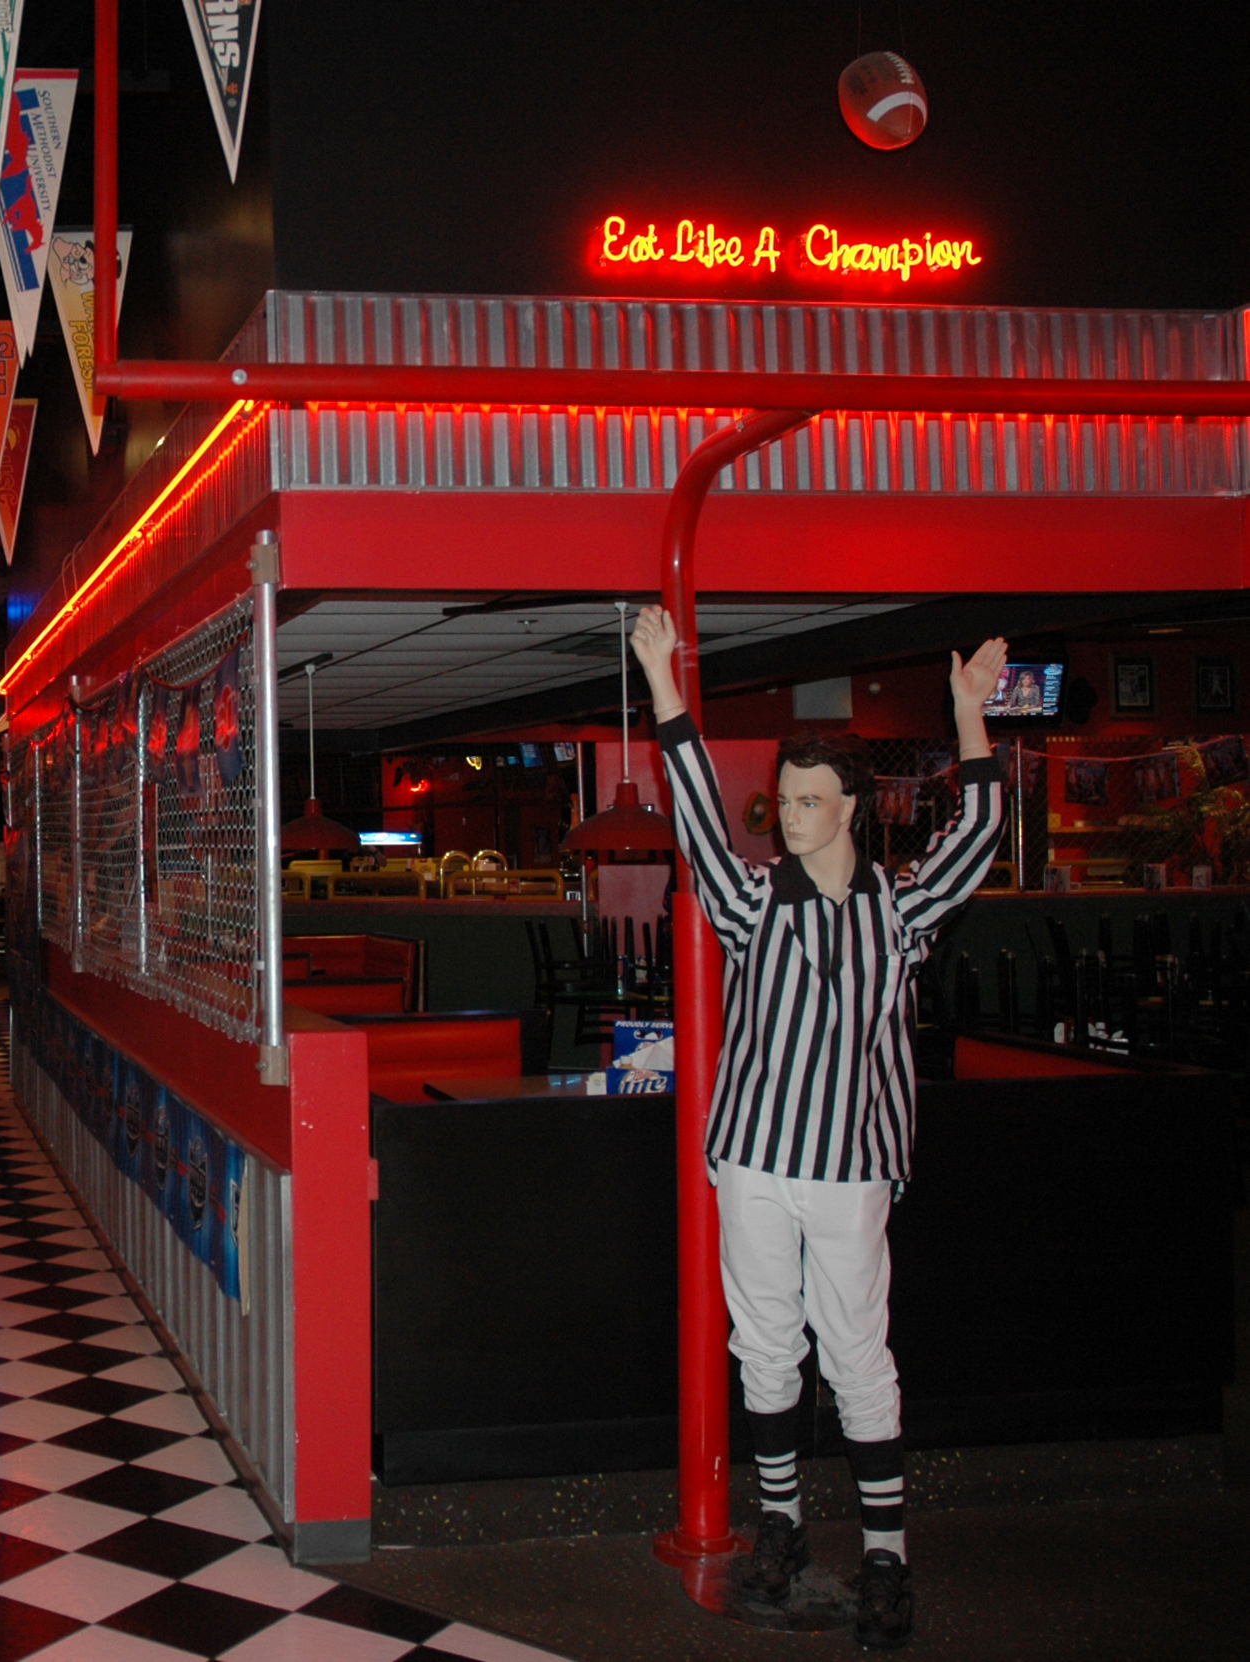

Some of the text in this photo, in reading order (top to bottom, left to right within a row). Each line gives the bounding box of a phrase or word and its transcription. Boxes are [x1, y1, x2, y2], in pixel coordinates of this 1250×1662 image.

[30, 112, 57, 179] METHODIST
[37, 89, 63, 150] SOUTHERN
[27, 143, 52, 212] UNIVERSITY
[604, 217, 981, 281] Eat Like A Champion
